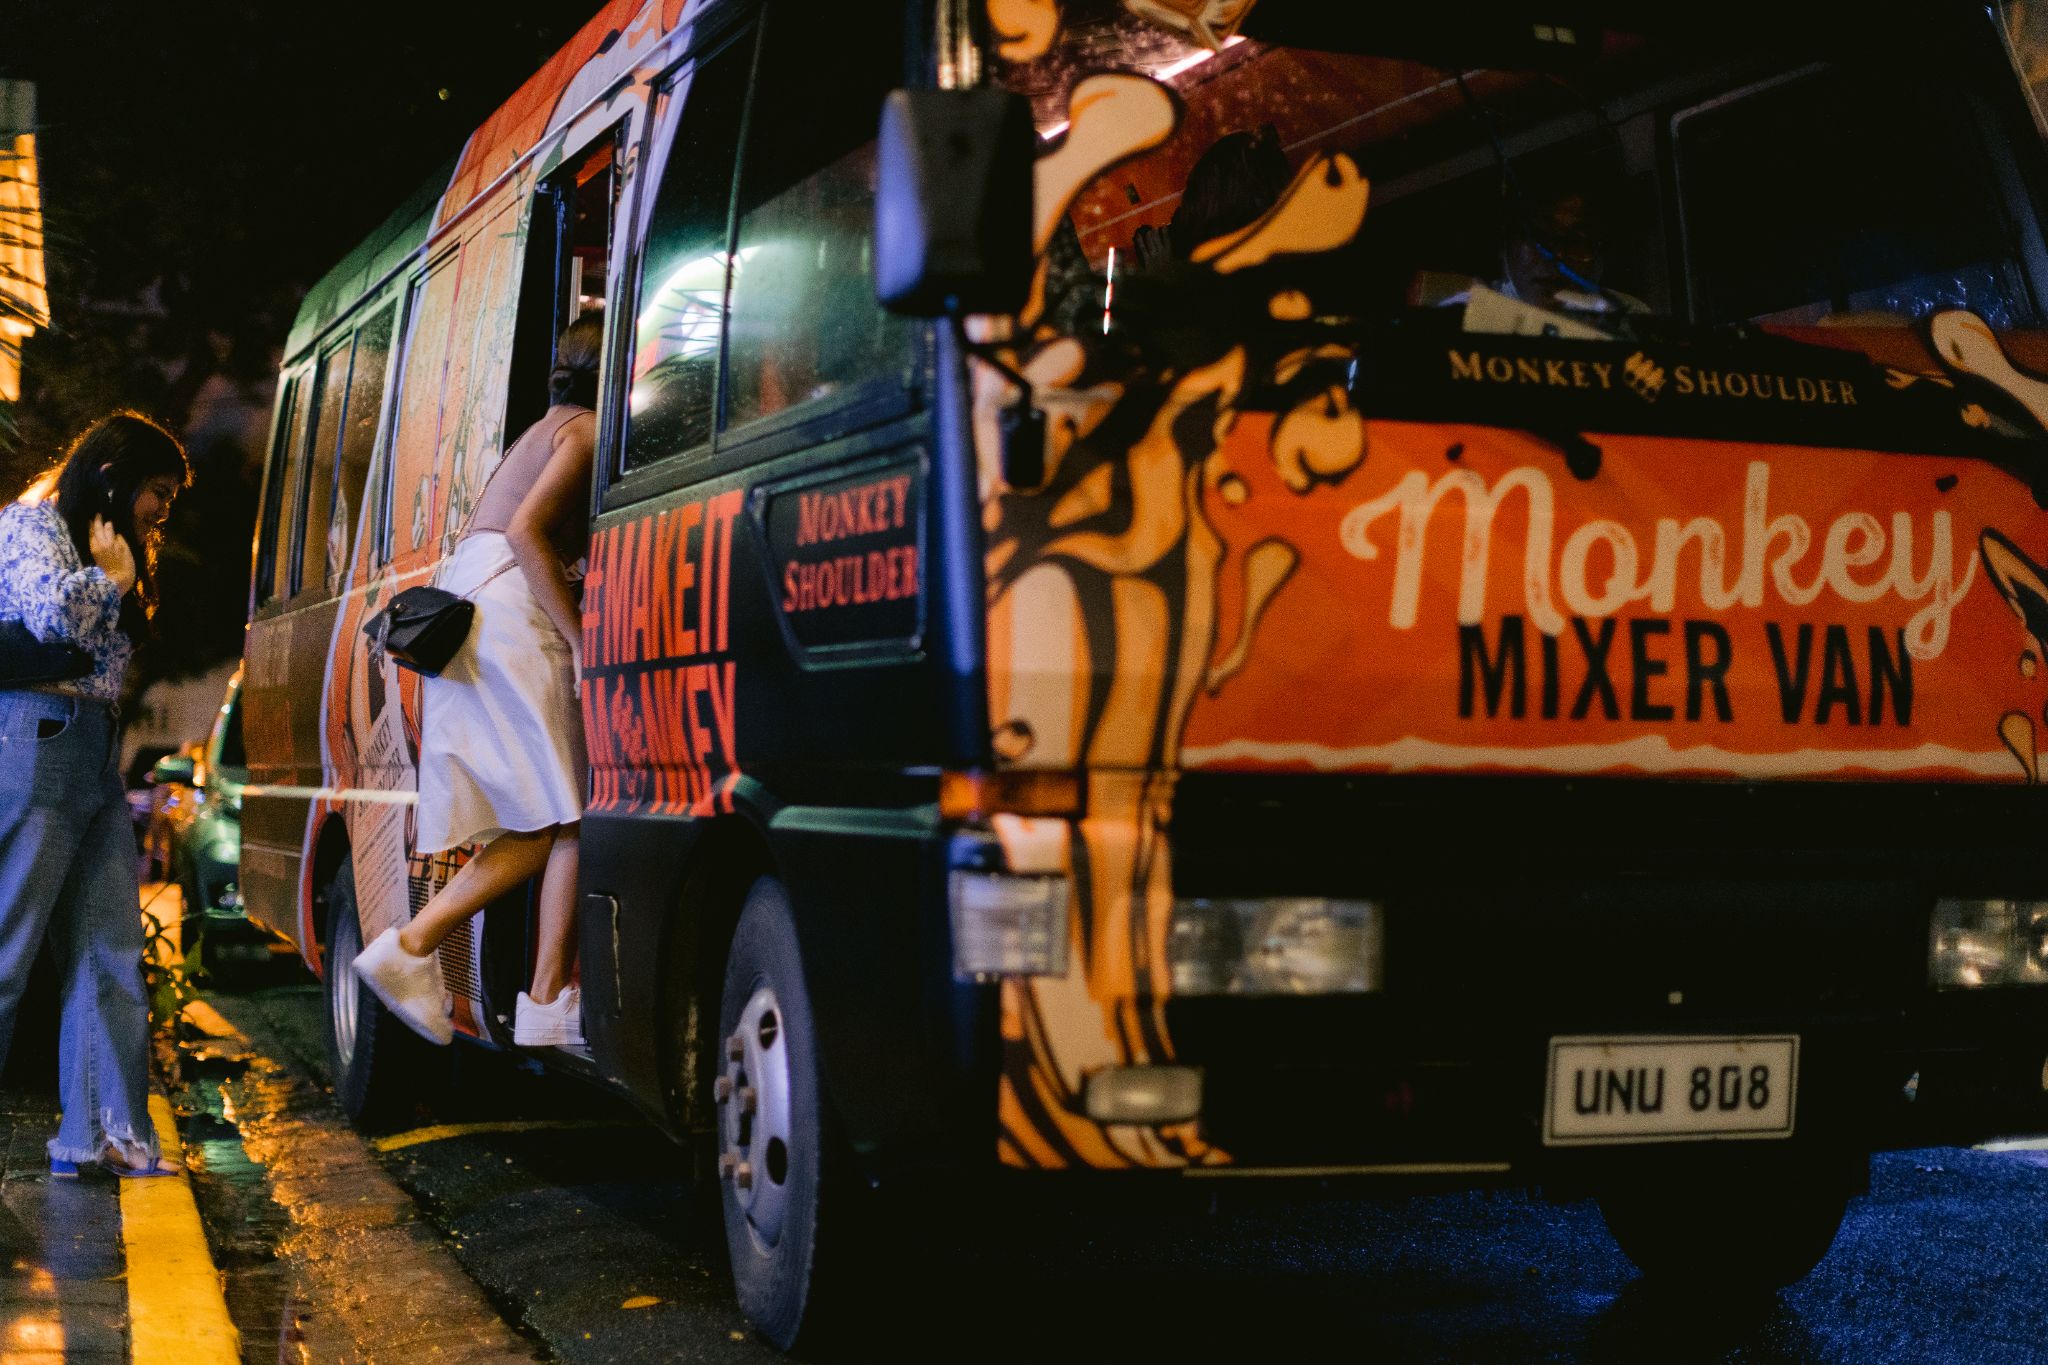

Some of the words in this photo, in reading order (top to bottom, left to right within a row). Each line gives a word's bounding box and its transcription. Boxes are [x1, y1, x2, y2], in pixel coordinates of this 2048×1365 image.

[1448, 349, 1613, 389] MONKEY
[1674, 364, 1858, 405] SHOULDER
[796, 475, 912, 546] MONKEY
[782, 544, 920, 613] SHOULDER
[1339, 460, 1980, 660] Monkey
[1457, 617, 1735, 723] MIXER
[1766, 622, 1915, 728] VAN
[1573, 1066, 1666, 1116] UNU
[1688, 1064, 1771, 1112] 808
